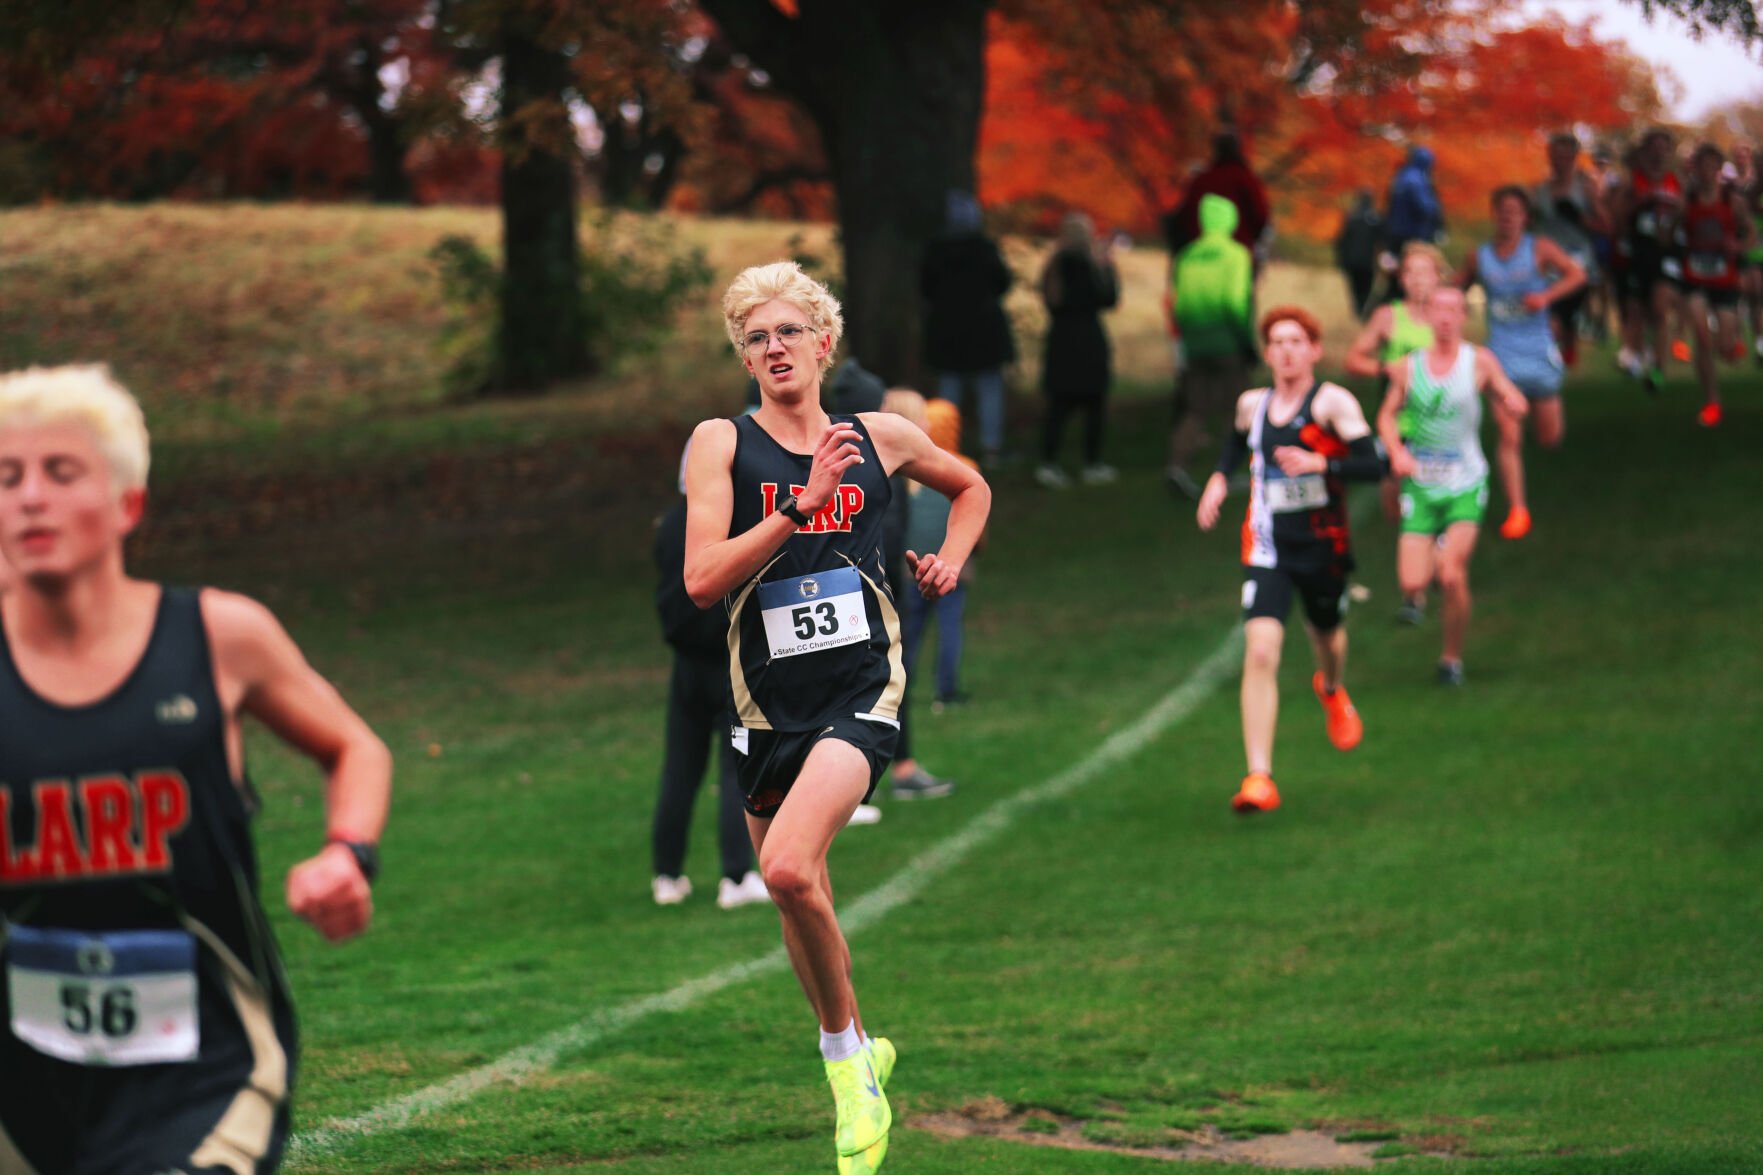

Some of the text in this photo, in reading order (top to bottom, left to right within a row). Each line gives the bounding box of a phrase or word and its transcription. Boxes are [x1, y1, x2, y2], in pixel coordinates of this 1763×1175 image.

[761, 483, 864, 533] LRP
[791, 602, 839, 640] 53
[777, 634, 862, 655] State CC Championships
[61, 984, 136, 1037] 56
